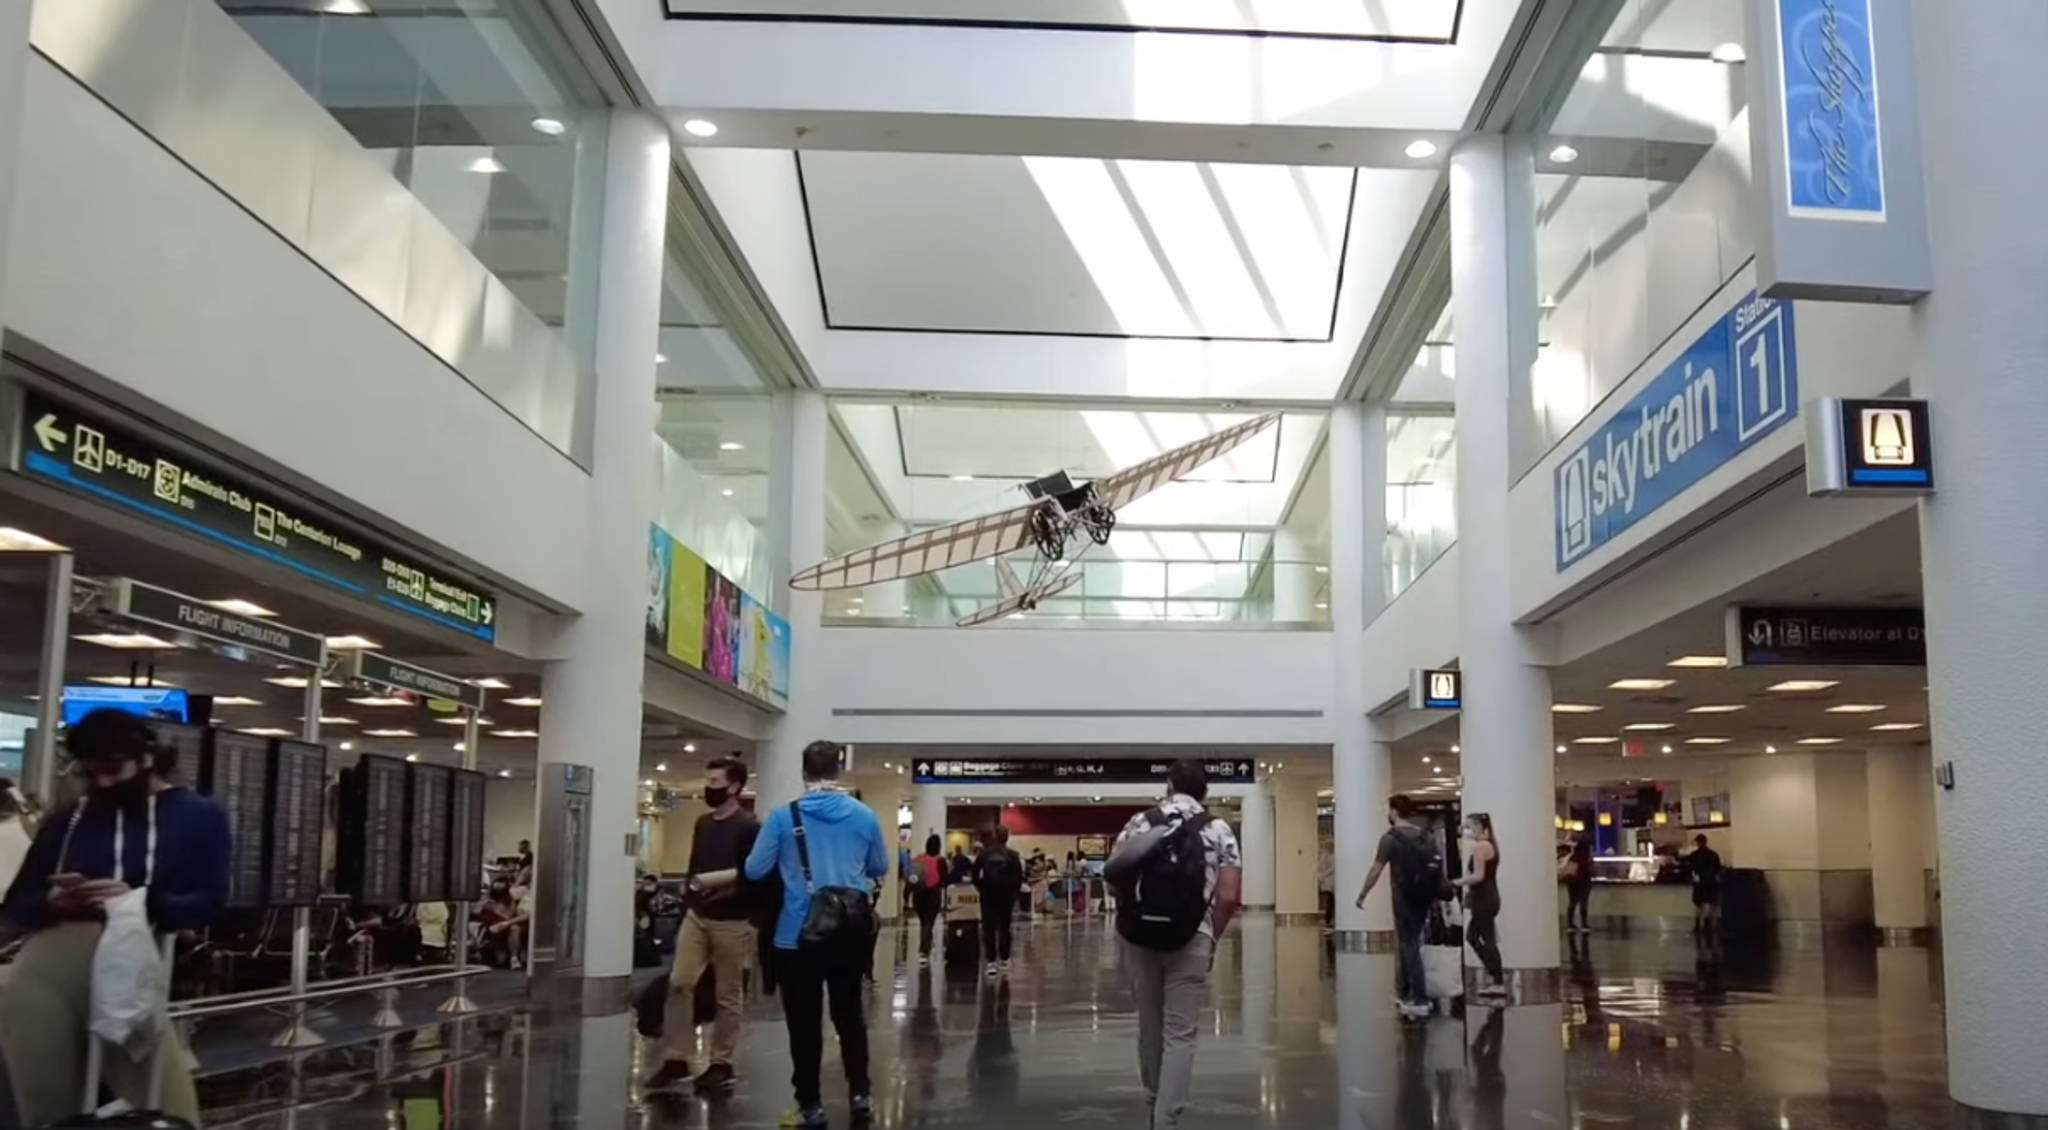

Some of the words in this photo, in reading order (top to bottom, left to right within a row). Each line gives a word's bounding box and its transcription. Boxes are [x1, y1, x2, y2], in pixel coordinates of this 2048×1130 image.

[1735, 296, 1776, 333] Statio
[1749, 332, 1768, 415] 1
[1592, 361, 1719, 516] skytrain
[105, 449, 151, 480] D1-D17
[181, 471, 228, 502] Admirals
[229, 491, 252, 512] Club
[276, 511, 293, 530] The
[333, 537, 362, 561] Lounge
[178, 604, 219, 629] FLIGHT
[221, 617, 290, 649] INFORMATION
[1810, 625, 1881, 641] Elevator
[1887, 626, 1903, 641] at
[389, 666, 416, 684] FLIGHT
[416, 674, 461, 697] INFORMATION
